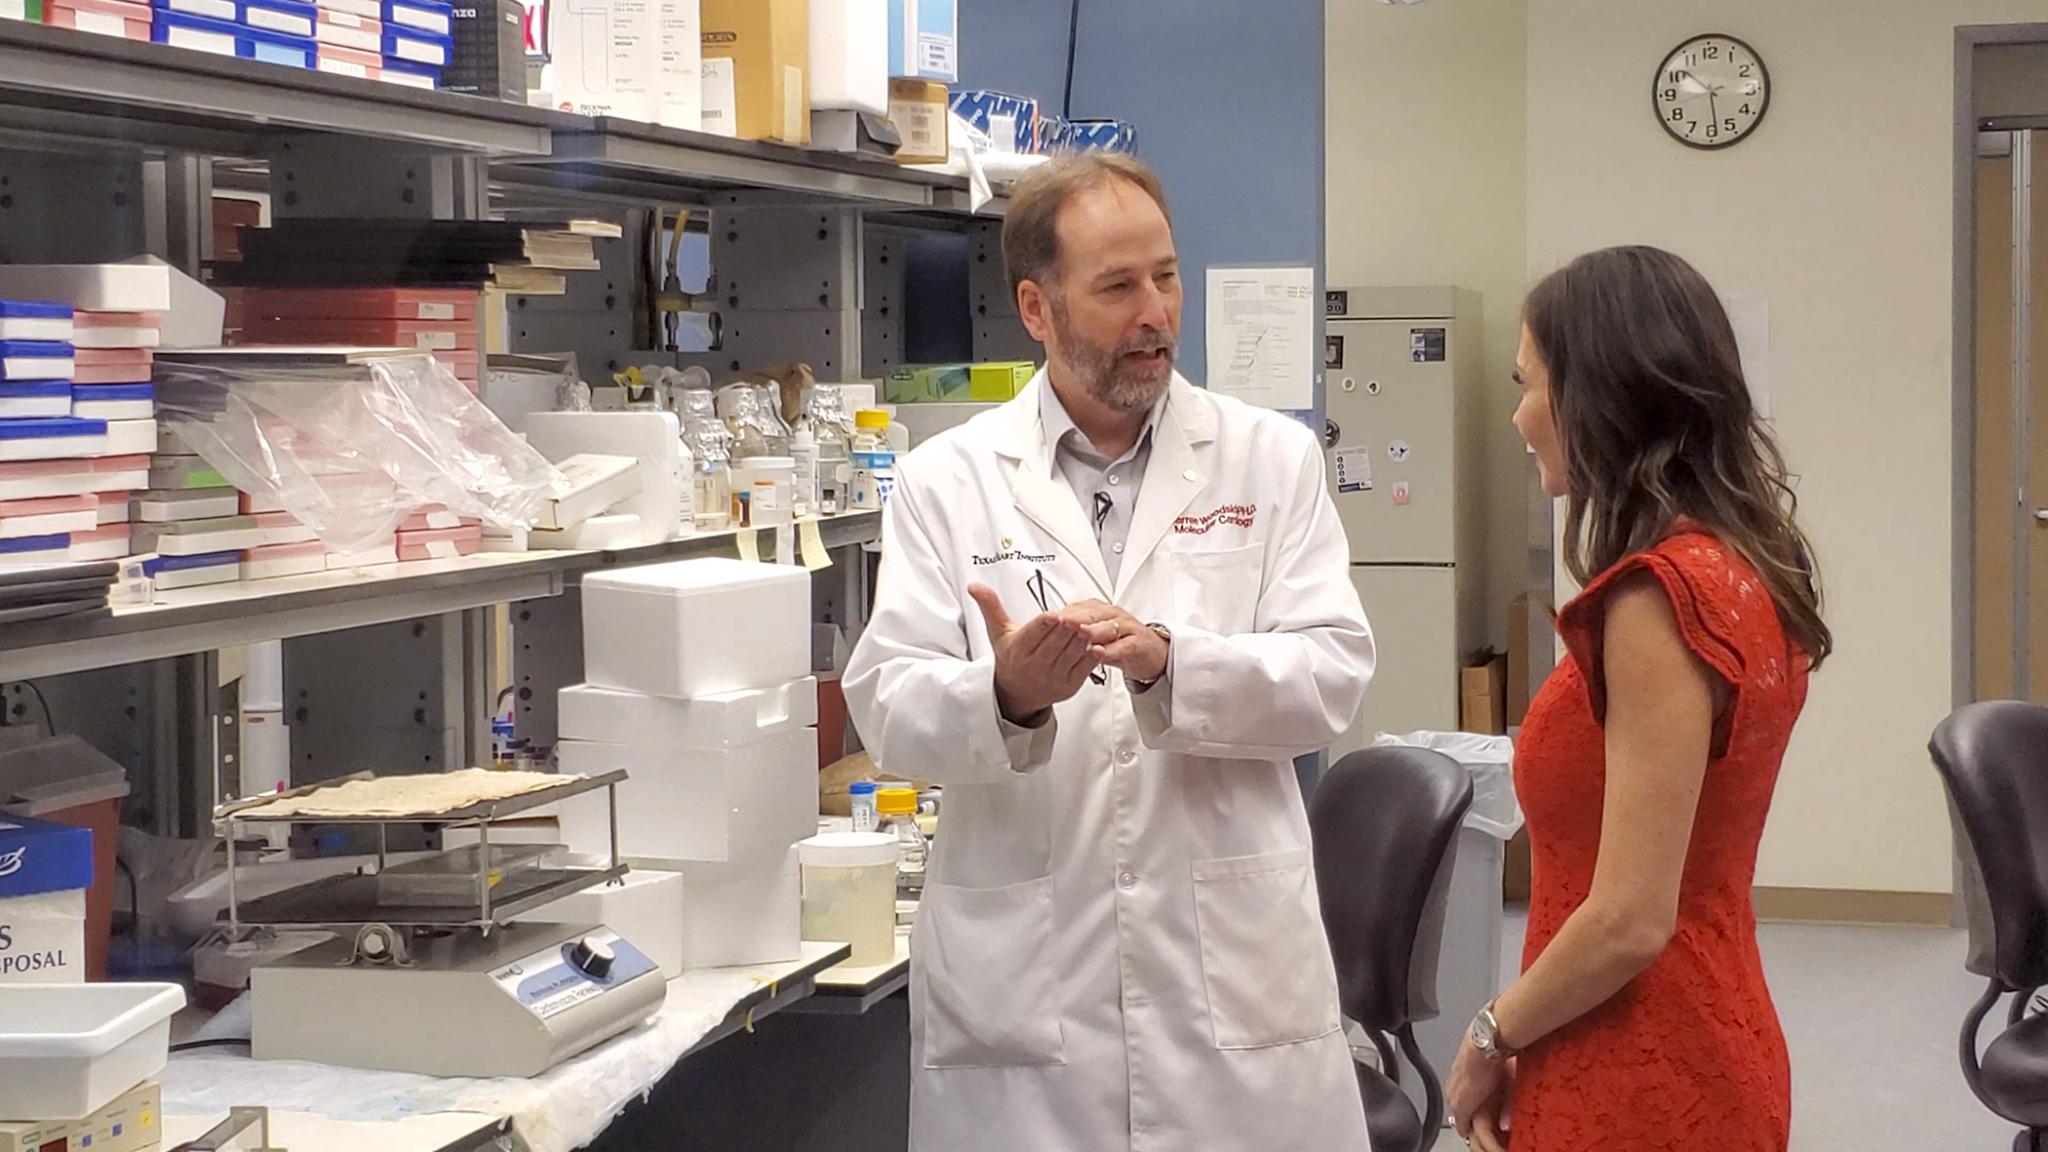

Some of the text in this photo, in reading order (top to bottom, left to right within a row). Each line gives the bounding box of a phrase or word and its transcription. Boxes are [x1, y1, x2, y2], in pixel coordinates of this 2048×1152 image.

[452, 9, 476, 18] nza
[1703, 46, 1718, 60] 12
[1729, 51, 1733, 63] 1
[1685, 54, 1696, 67] 11
[1669, 70, 1687, 83] 10
[1739, 64, 1750, 78] 2
[1664, 88, 1676, 102] 9
[1745, 83, 1756, 96] 3
[1672, 107, 1683, 121] 8
[1738, 103, 1750, 115] 4
[1686, 121, 1697, 133] 7
[1706, 124, 1717, 138] 6
[1724, 118, 1735, 131] 5
[1174, 516, 1199, 525] arren
